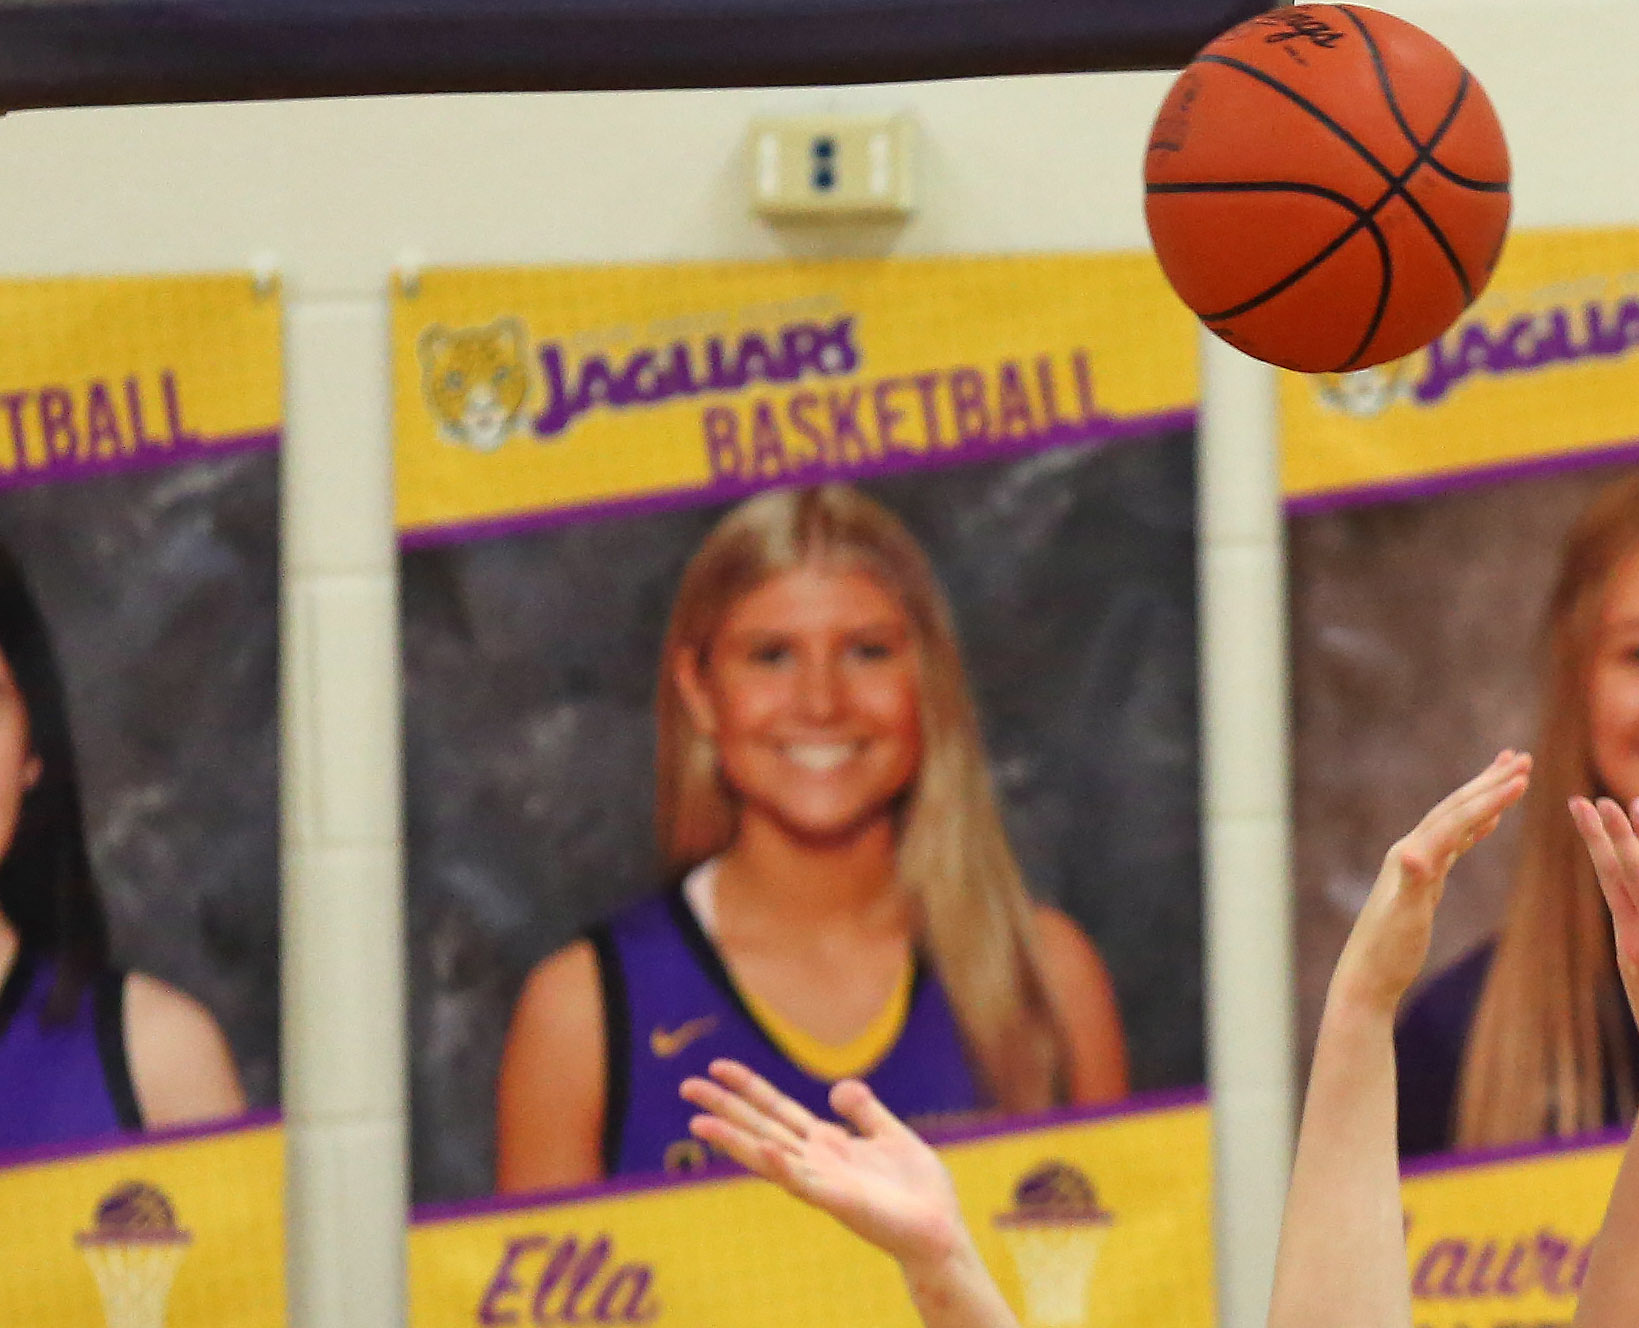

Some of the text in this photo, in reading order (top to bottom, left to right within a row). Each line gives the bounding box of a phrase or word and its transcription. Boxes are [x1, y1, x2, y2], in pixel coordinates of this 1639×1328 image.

[533, 316, 859, 438] JAGUARS
[704, 347, 1100, 481] BASKETBALL
[477, 1234, 660, 1328] Ella
[1409, 1228, 1594, 1298] aur
